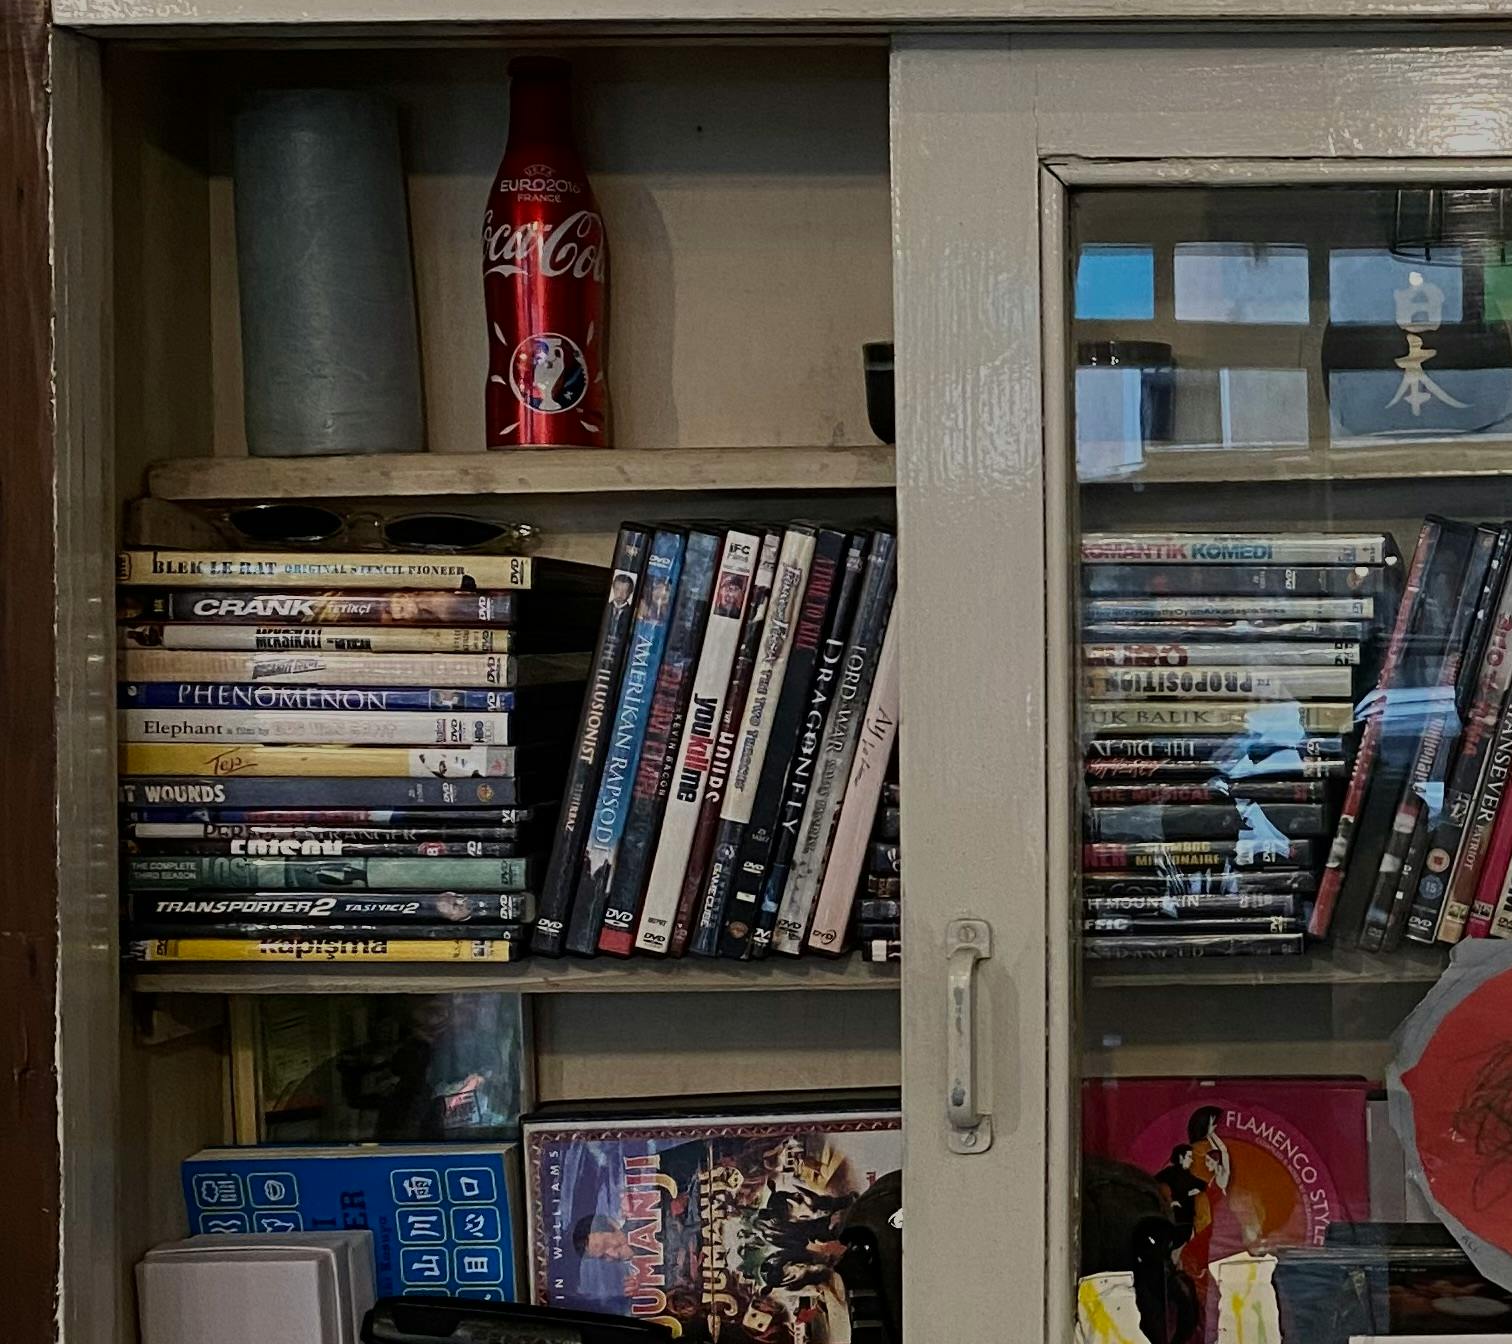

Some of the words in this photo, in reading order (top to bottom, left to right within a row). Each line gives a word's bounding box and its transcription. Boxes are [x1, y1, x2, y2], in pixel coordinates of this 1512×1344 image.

[516, 192, 563, 205] FRANCE
[152, 552, 203, 574] BLEK
[210, 560, 234, 574] LE
[239, 559, 277, 574] RAT
[407, 564, 466, 576] PIONEER
[192, 598, 316, 618] CRANK
[837, 645, 867, 701] LORD
[1106, 671, 1253, 693] PROPOSITION
[177, 685, 387, 711] PHENOMENON
[613, 633, 655, 751] AMERİKAN
[144, 720, 222, 738] Elephant
[579, 668, 612, 766] ILLUSIONIST
[666, 714, 684, 750] KEVIN
[782, 637, 843, 836] DRAGONFLY
[824, 706, 856, 755] WAR
[656, 754, 675, 797] BACON
[144, 784, 226, 804] WOUNDS
[1131, 787, 1213, 802] MUSICAL
[1463, 823, 1487, 871] PATRIOT
[537, 917, 564, 930] DVD
[605, 907, 633, 923] DVD
[402, 1175, 433, 1201] 雨
[458, 1175, 480, 1197] 口
[1226, 1110, 1318, 1184] FLAMENCO
[1309, 1188, 1330, 1246] STYLE
[547, 1149, 564, 1261] WILLIAMS
[407, 1214, 442, 1238] 川
[463, 1212, 486, 1238] 心
[698, 1165, 745, 1318] JUMANJI
[411, 1254, 442, 1277] 山
[462, 1255, 489, 1274] 目
